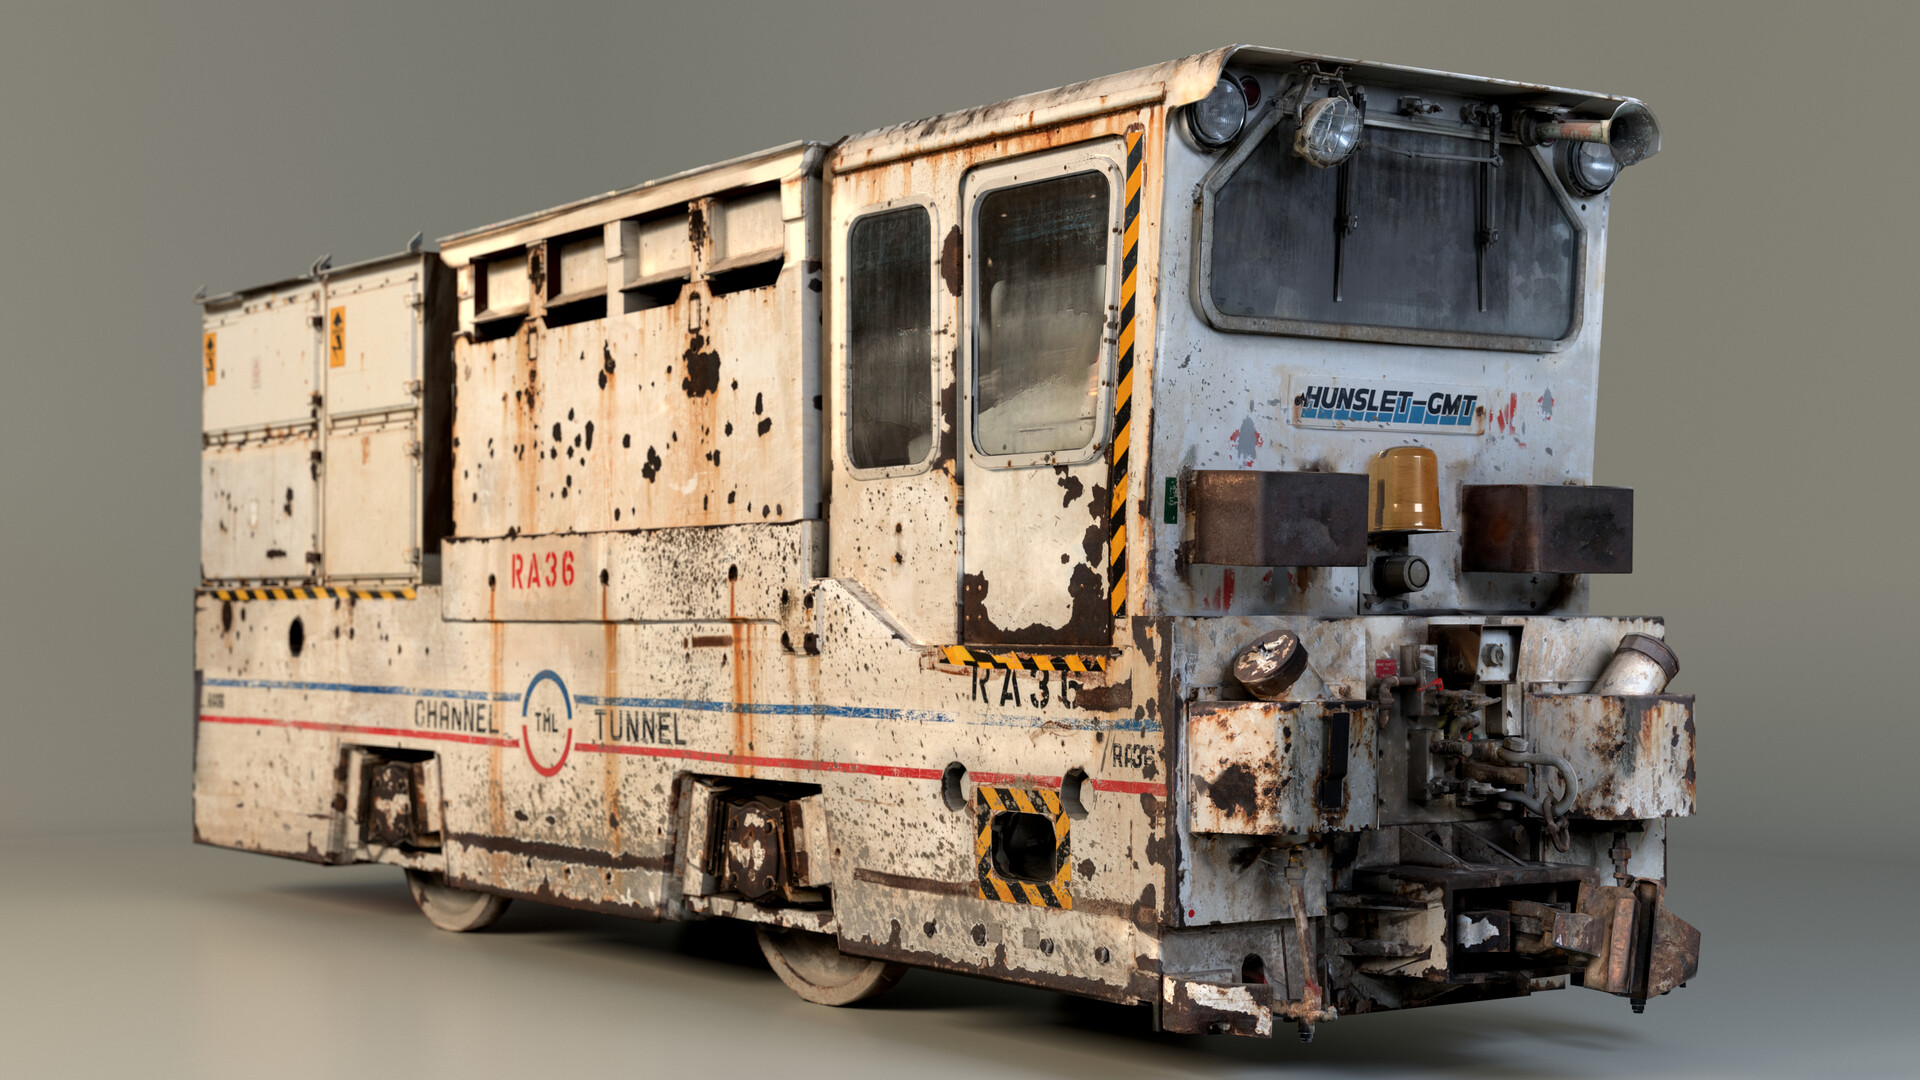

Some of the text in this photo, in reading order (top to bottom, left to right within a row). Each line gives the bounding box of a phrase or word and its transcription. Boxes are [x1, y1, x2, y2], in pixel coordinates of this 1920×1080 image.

[1303, 385, 1478, 416] HUNSLET-GMT
[511, 550, 575, 590] RA36
[971, 665, 1082, 710] RA36
[414, 699, 687, 746] CHANNEL TUNNEL
[534, 711, 559, 733] TML
[1112, 743, 1155, 768] RA36
